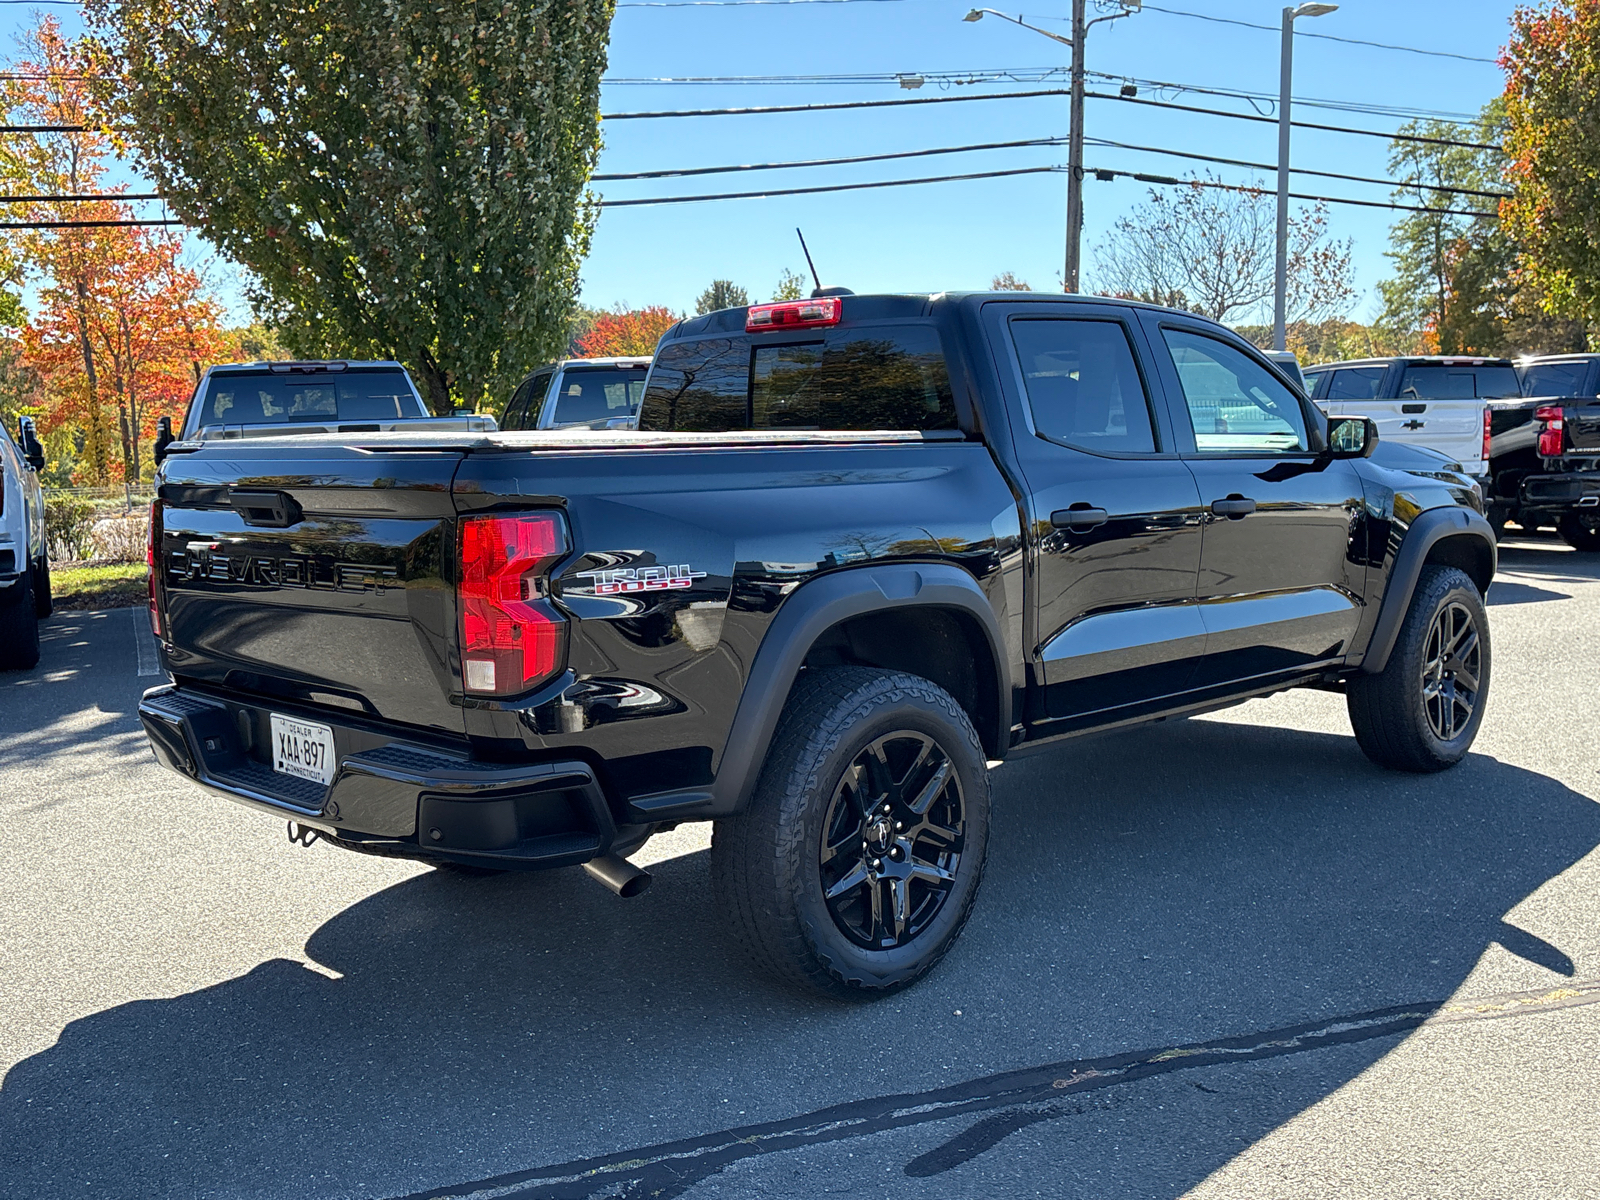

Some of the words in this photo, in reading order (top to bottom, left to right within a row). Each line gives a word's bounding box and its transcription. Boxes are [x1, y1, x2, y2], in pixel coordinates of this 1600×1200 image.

[577, 564, 707, 584] TRAIL
[595, 577, 692, 595] BOSS
[289, 724, 312, 738] DEALER
[286, 763, 321, 780] CONNECTICUT
